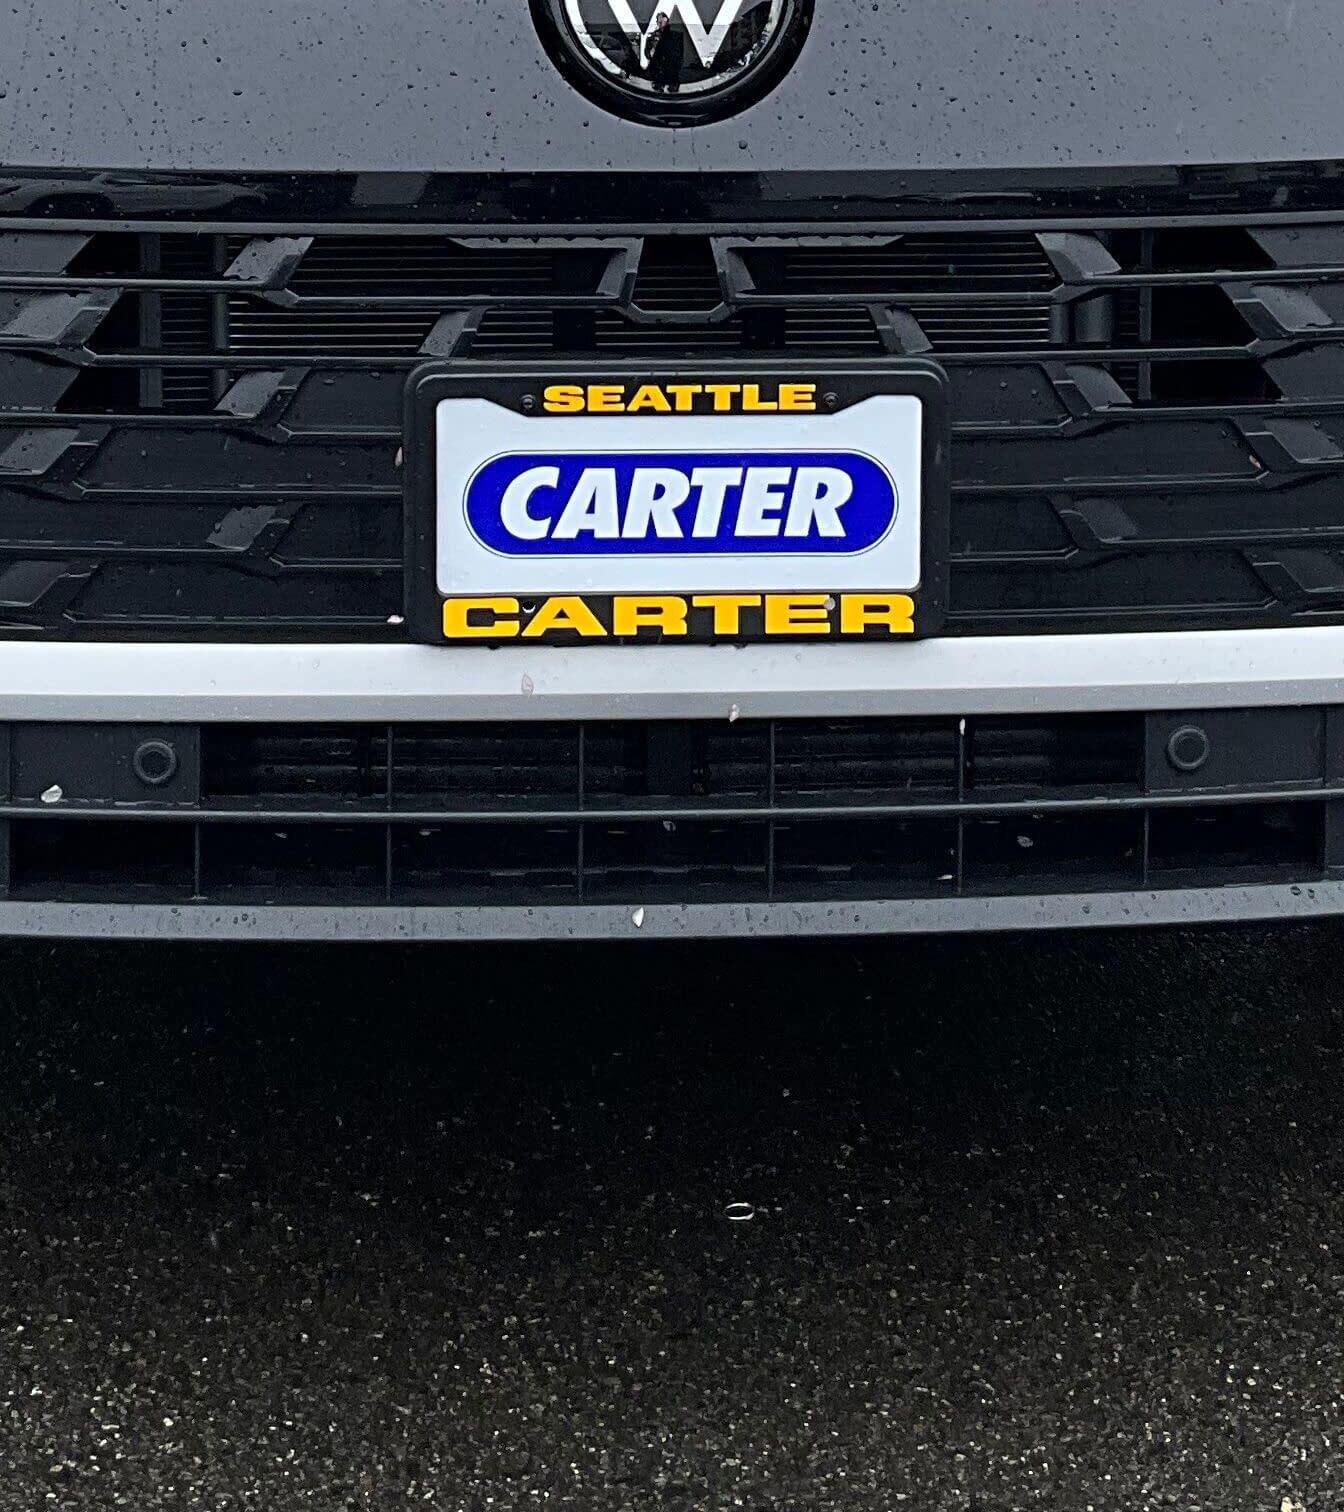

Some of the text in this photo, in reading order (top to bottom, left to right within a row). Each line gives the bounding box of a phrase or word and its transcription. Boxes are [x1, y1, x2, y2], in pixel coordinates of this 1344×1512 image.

[543, 384, 816, 413] SEATTLE
[499, 466, 853, 541] CARTER
[442, 594, 915, 639] CARTER
